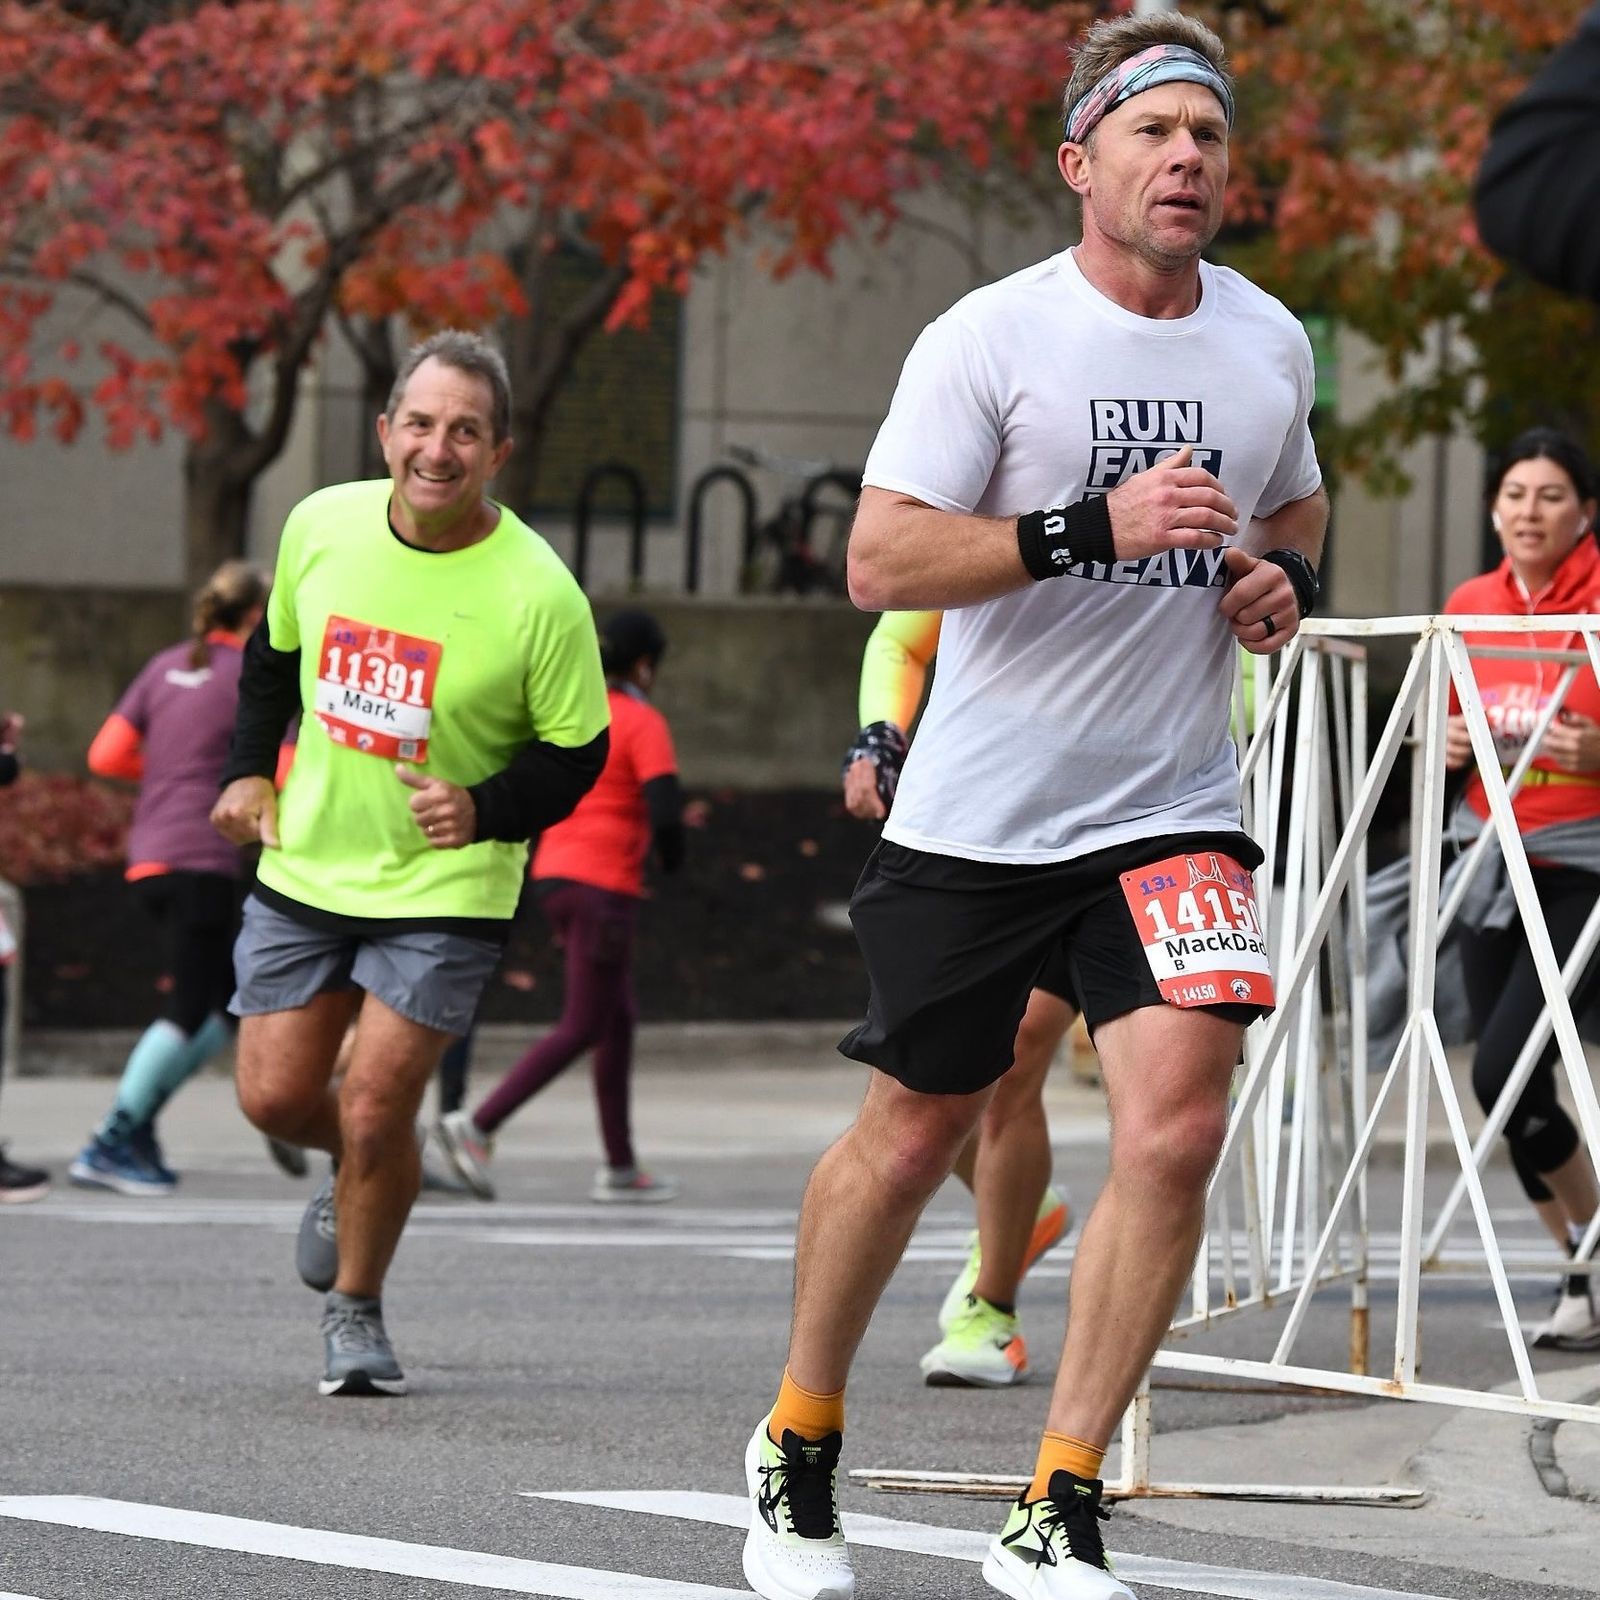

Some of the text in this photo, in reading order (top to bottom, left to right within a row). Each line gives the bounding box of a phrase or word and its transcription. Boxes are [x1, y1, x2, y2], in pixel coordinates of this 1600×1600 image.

[1093, 400, 1199, 441] RUN
[1091, 448, 1211, 486] FAT
[325, 647, 425, 706] 11391
[343, 690, 397, 722] Mark
[1174, 959, 1185, 971] B
[1182, 983, 1217, 1001] 14150
